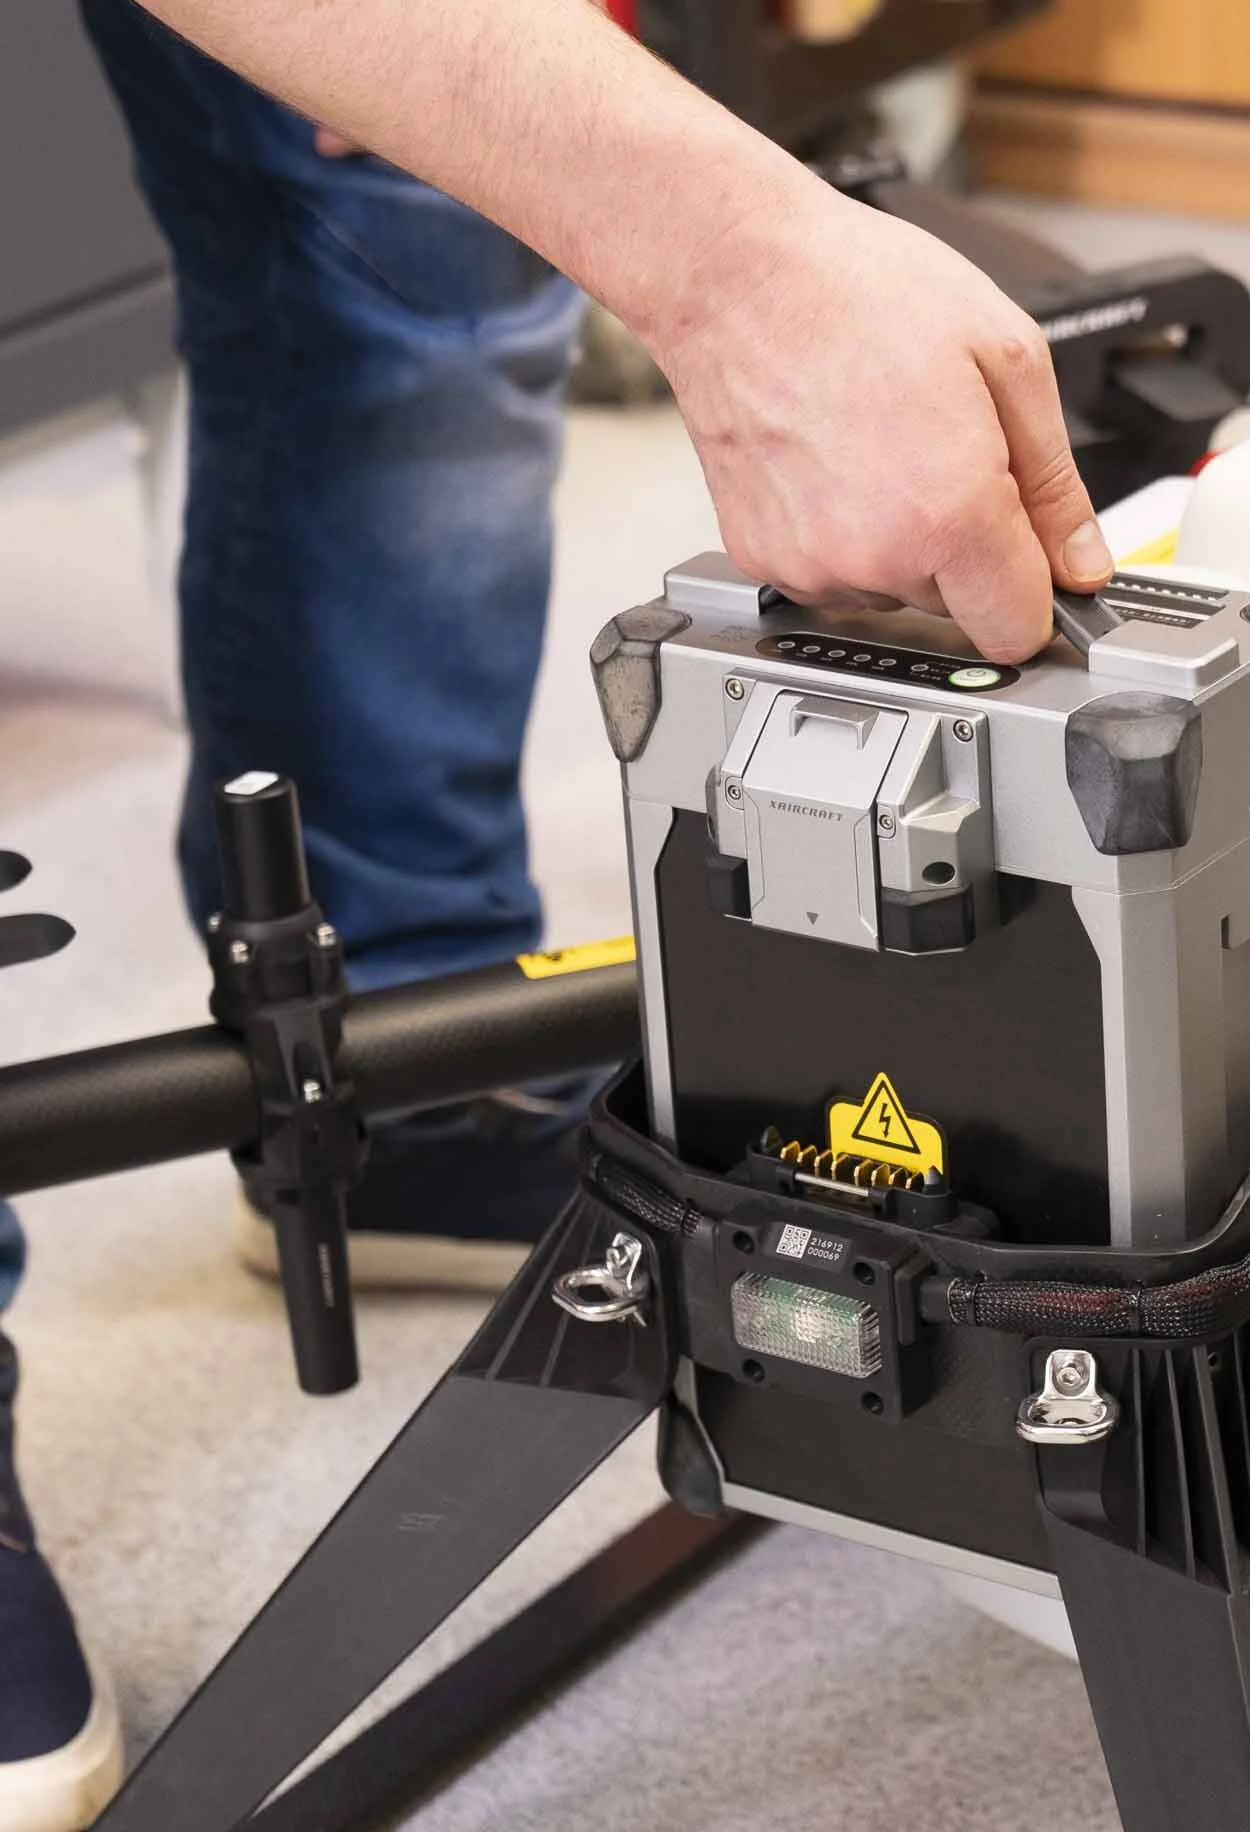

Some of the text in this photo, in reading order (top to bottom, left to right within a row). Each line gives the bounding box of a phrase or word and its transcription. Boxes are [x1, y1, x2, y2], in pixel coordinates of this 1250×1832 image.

[769, 799, 843, 821] XAIRCRAFT
[810, 1237, 844, 1252] 216912
[807, 1246, 840, 1261] 000069
